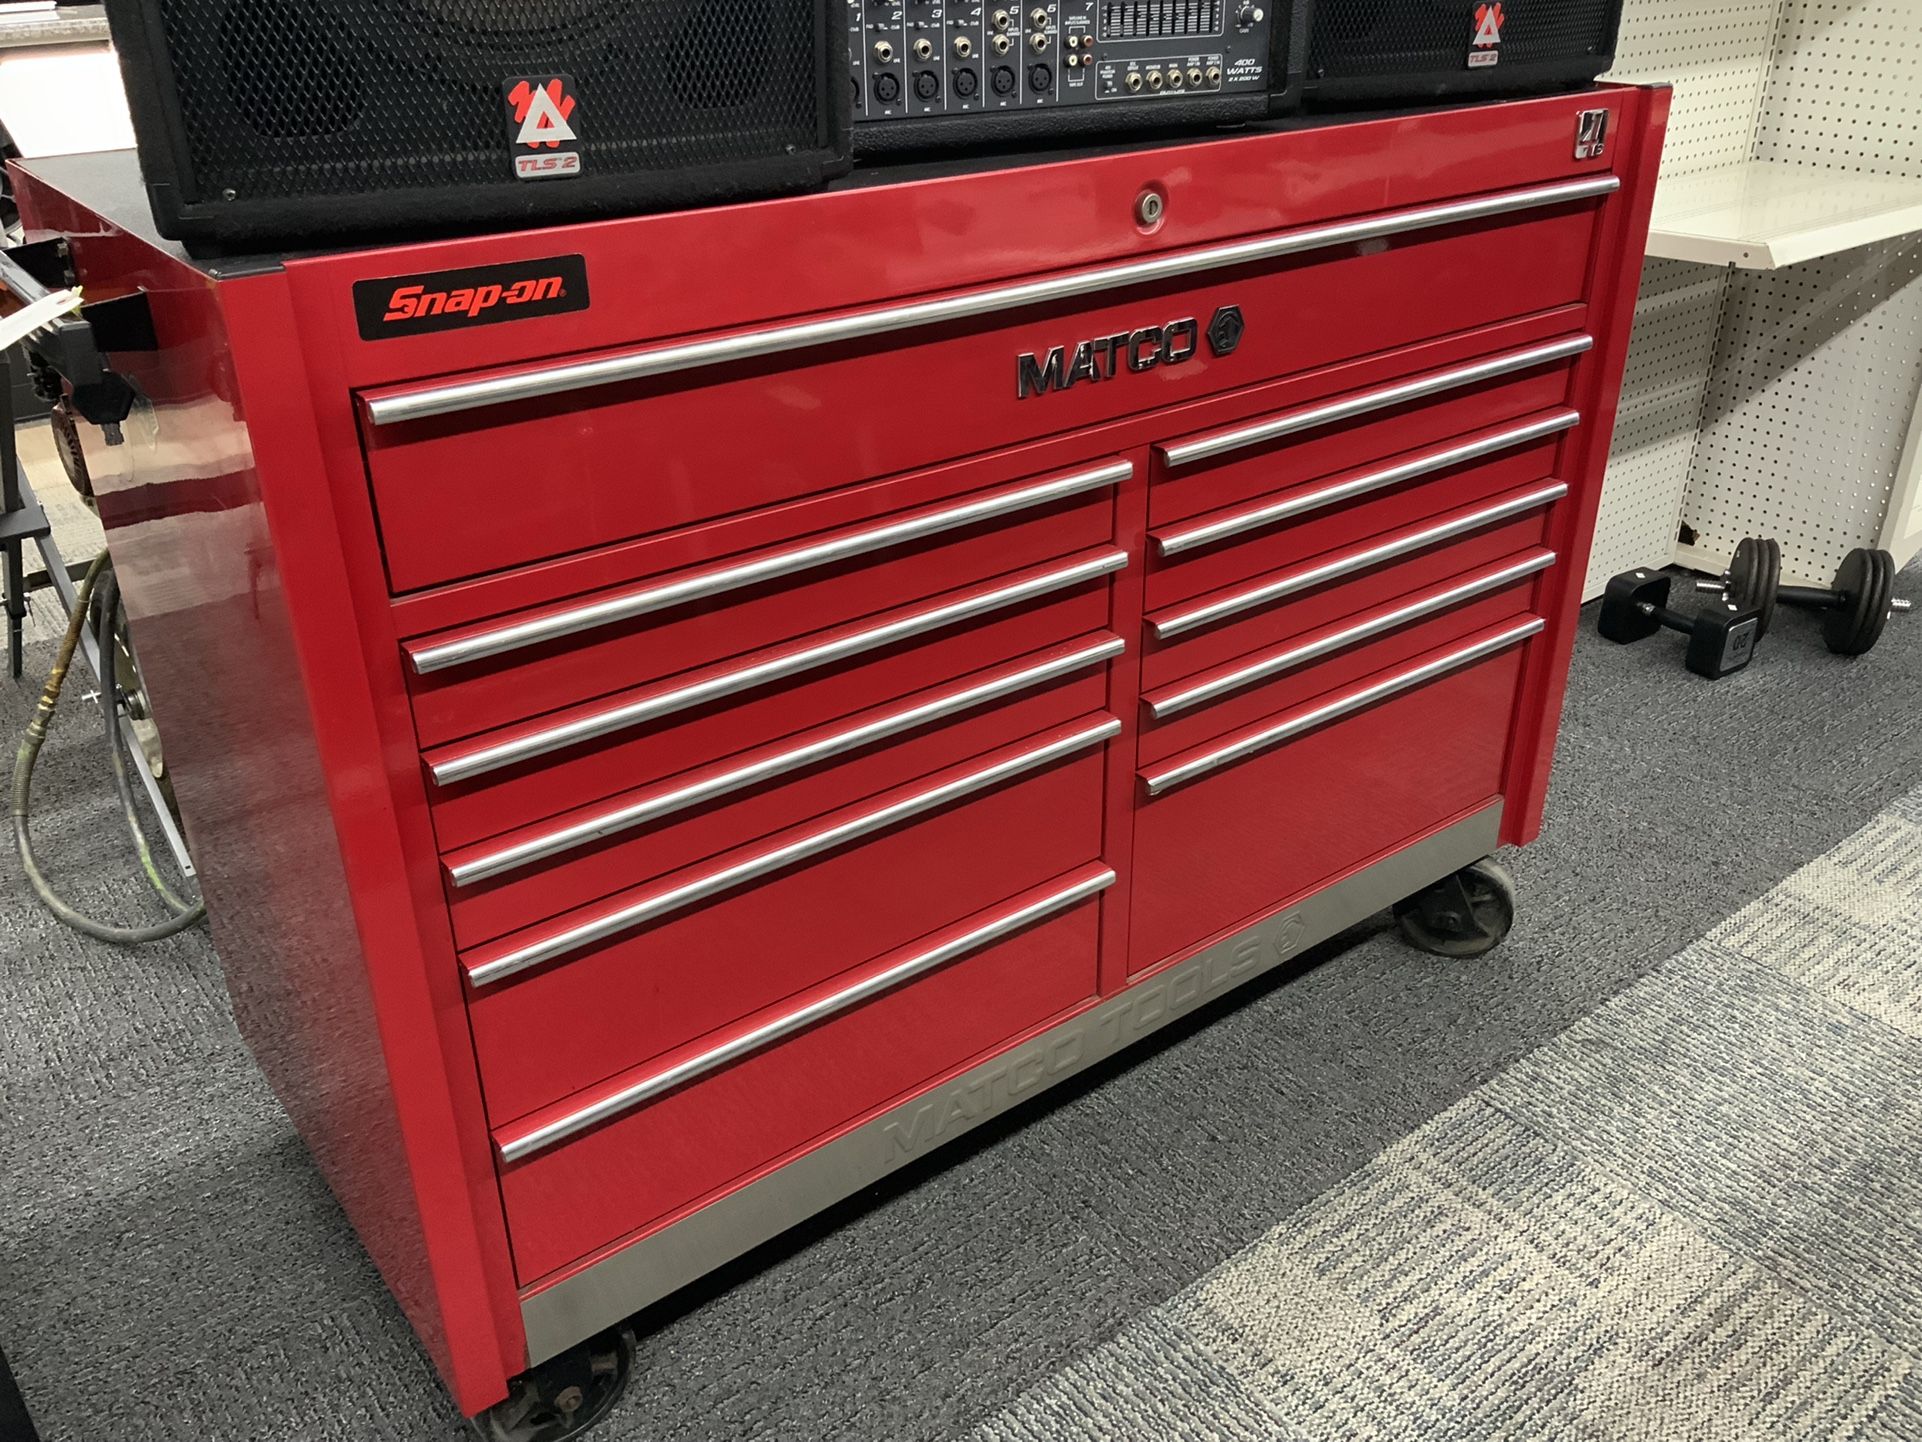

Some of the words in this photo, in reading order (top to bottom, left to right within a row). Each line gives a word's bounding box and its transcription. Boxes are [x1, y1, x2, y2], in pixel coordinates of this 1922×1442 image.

[970, 7, 982, 16] 4
[1009, 5, 1020, 15] 5
[1047, 3, 1057, 13] 6
[1085, 2, 1094, 11] 7
[856, 12, 861, 22] 1
[891, 11, 902, 20] 2
[931, 9, 942, 18] 3
[1234, 58, 1255, 66] 400
[1226, 66, 1263, 75] WATTS
[518, 158, 559, 172] TLS
[562, 156, 578, 169] 2
[383, 276, 564, 322] Snap-on
[1017, 317, 1198, 399] MATCO
[883, 1027, 1085, 1164] MATCO
[1100, 935, 1262, 1048] TOOLS
